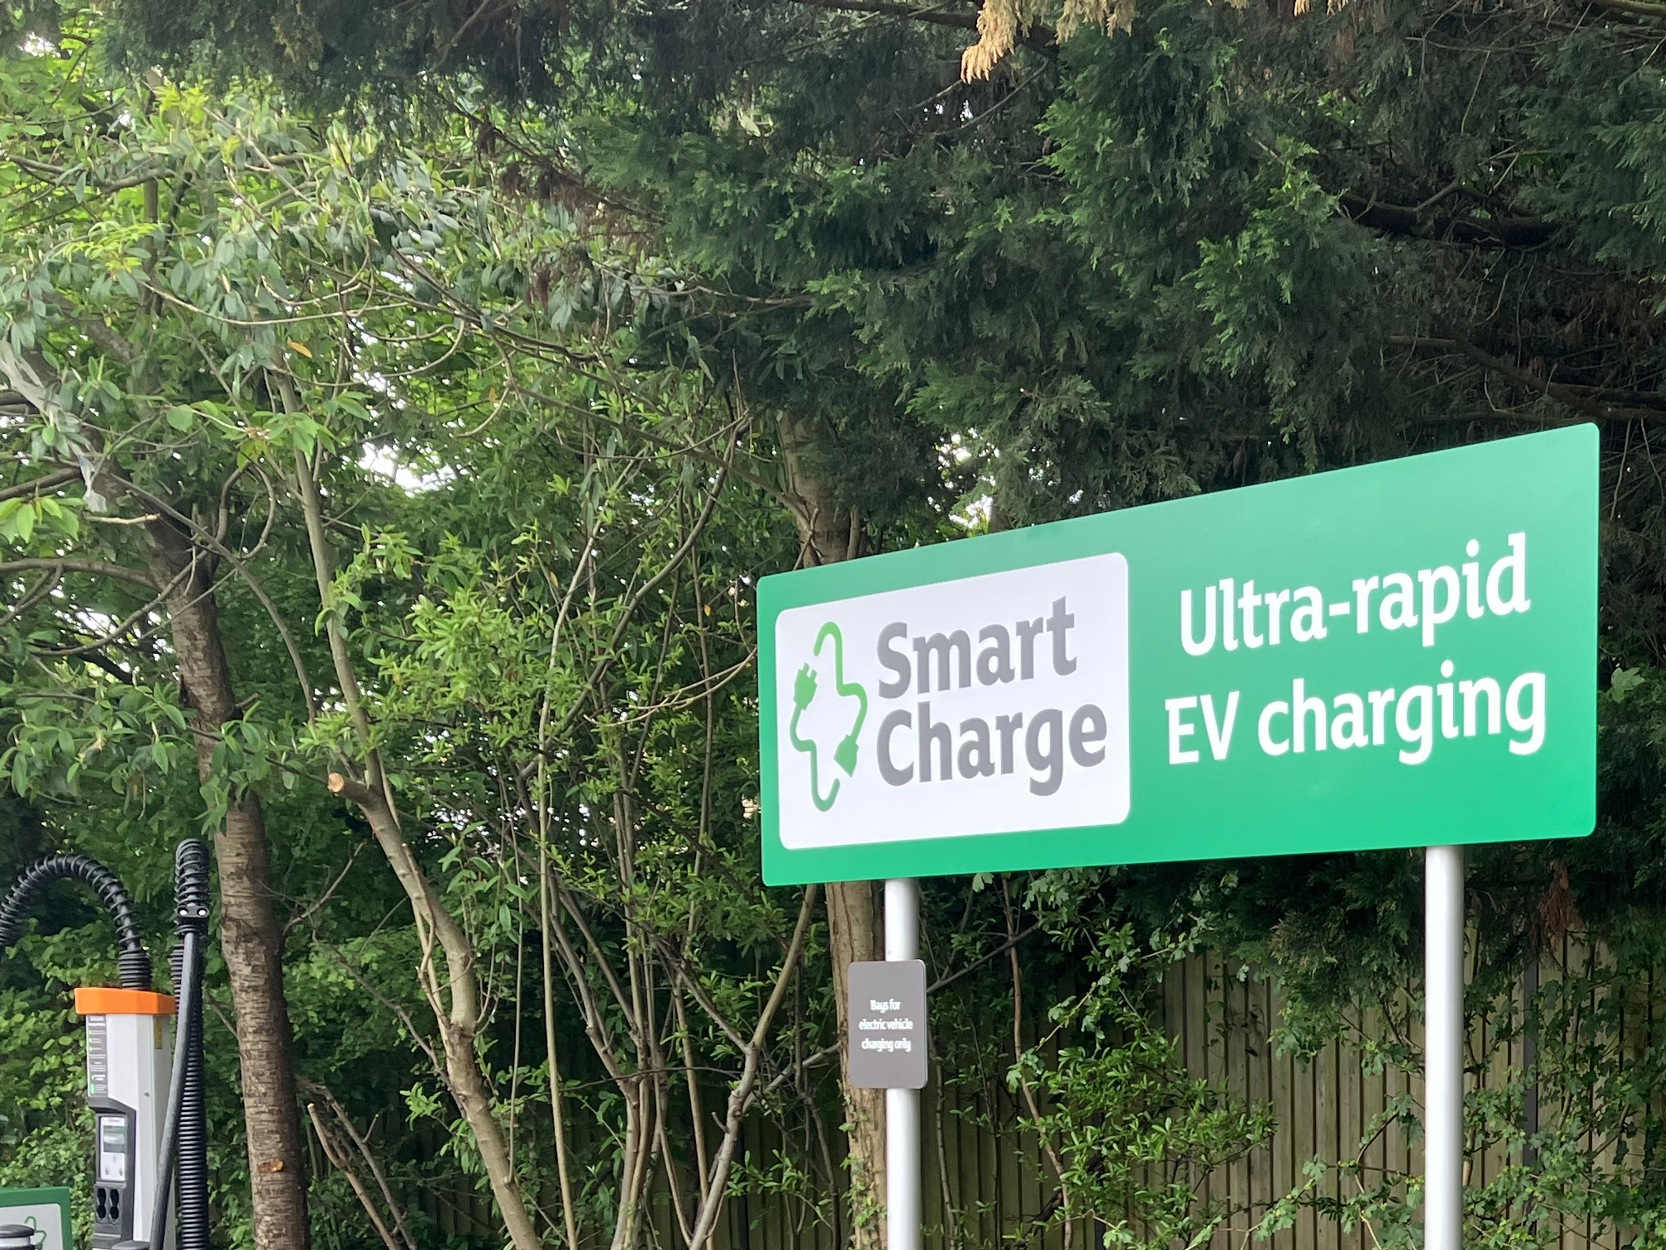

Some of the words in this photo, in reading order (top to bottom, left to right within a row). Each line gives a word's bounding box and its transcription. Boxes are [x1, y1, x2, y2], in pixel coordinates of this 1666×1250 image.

[1179, 531, 1530, 657] Ultra-rapid
[875, 595, 1078, 699] Smart
[875, 702, 1108, 797] Charge
[1165, 690, 1240, 766] EV
[1257, 658, 1547, 766] charging
[858, 1018, 886, 1030] electric
[887, 1018, 913, 1030] vehicle
[861, 1038, 893, 1052] charging
[894, 1038, 911, 1052] only
[870, 999, 888, 1013] Bays
[889, 998, 901, 1010] for
